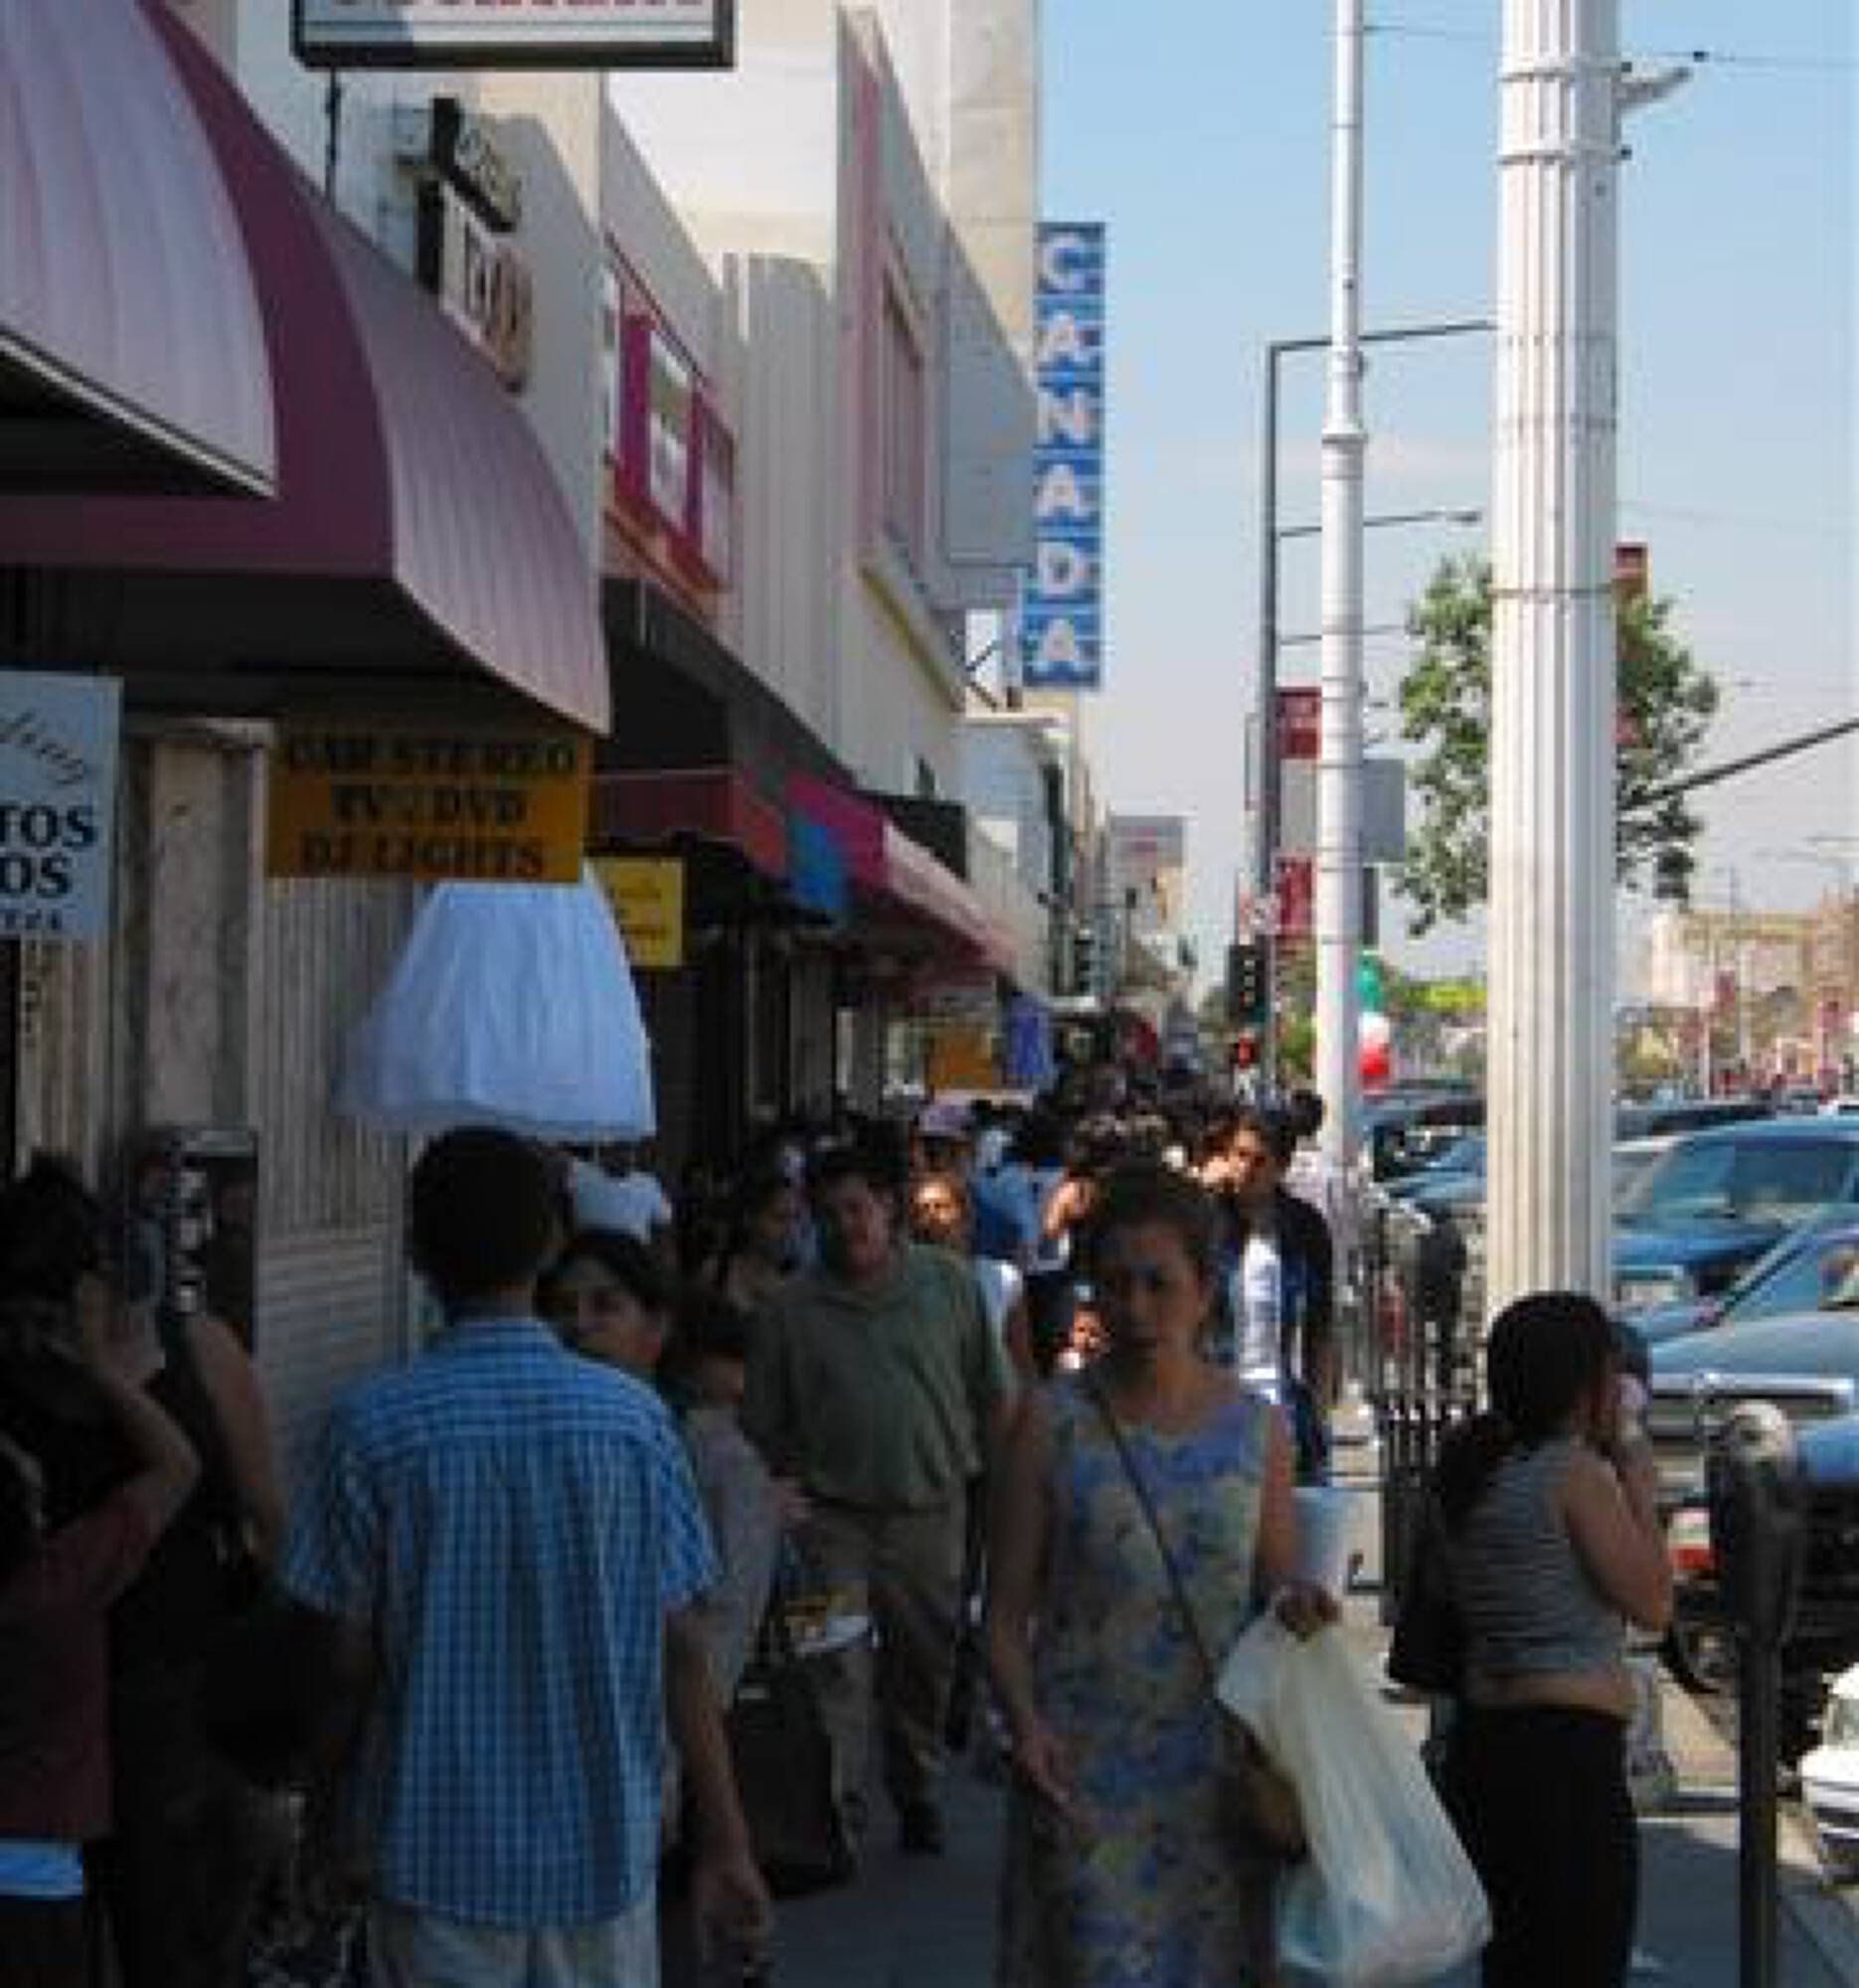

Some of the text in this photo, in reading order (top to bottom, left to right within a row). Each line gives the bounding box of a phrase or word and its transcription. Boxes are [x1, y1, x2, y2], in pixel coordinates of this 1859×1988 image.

[1036, 232, 1091, 673] CANADA
[431, 786, 527, 824] DVD
[374, 835, 544, 878] LIGHTS
